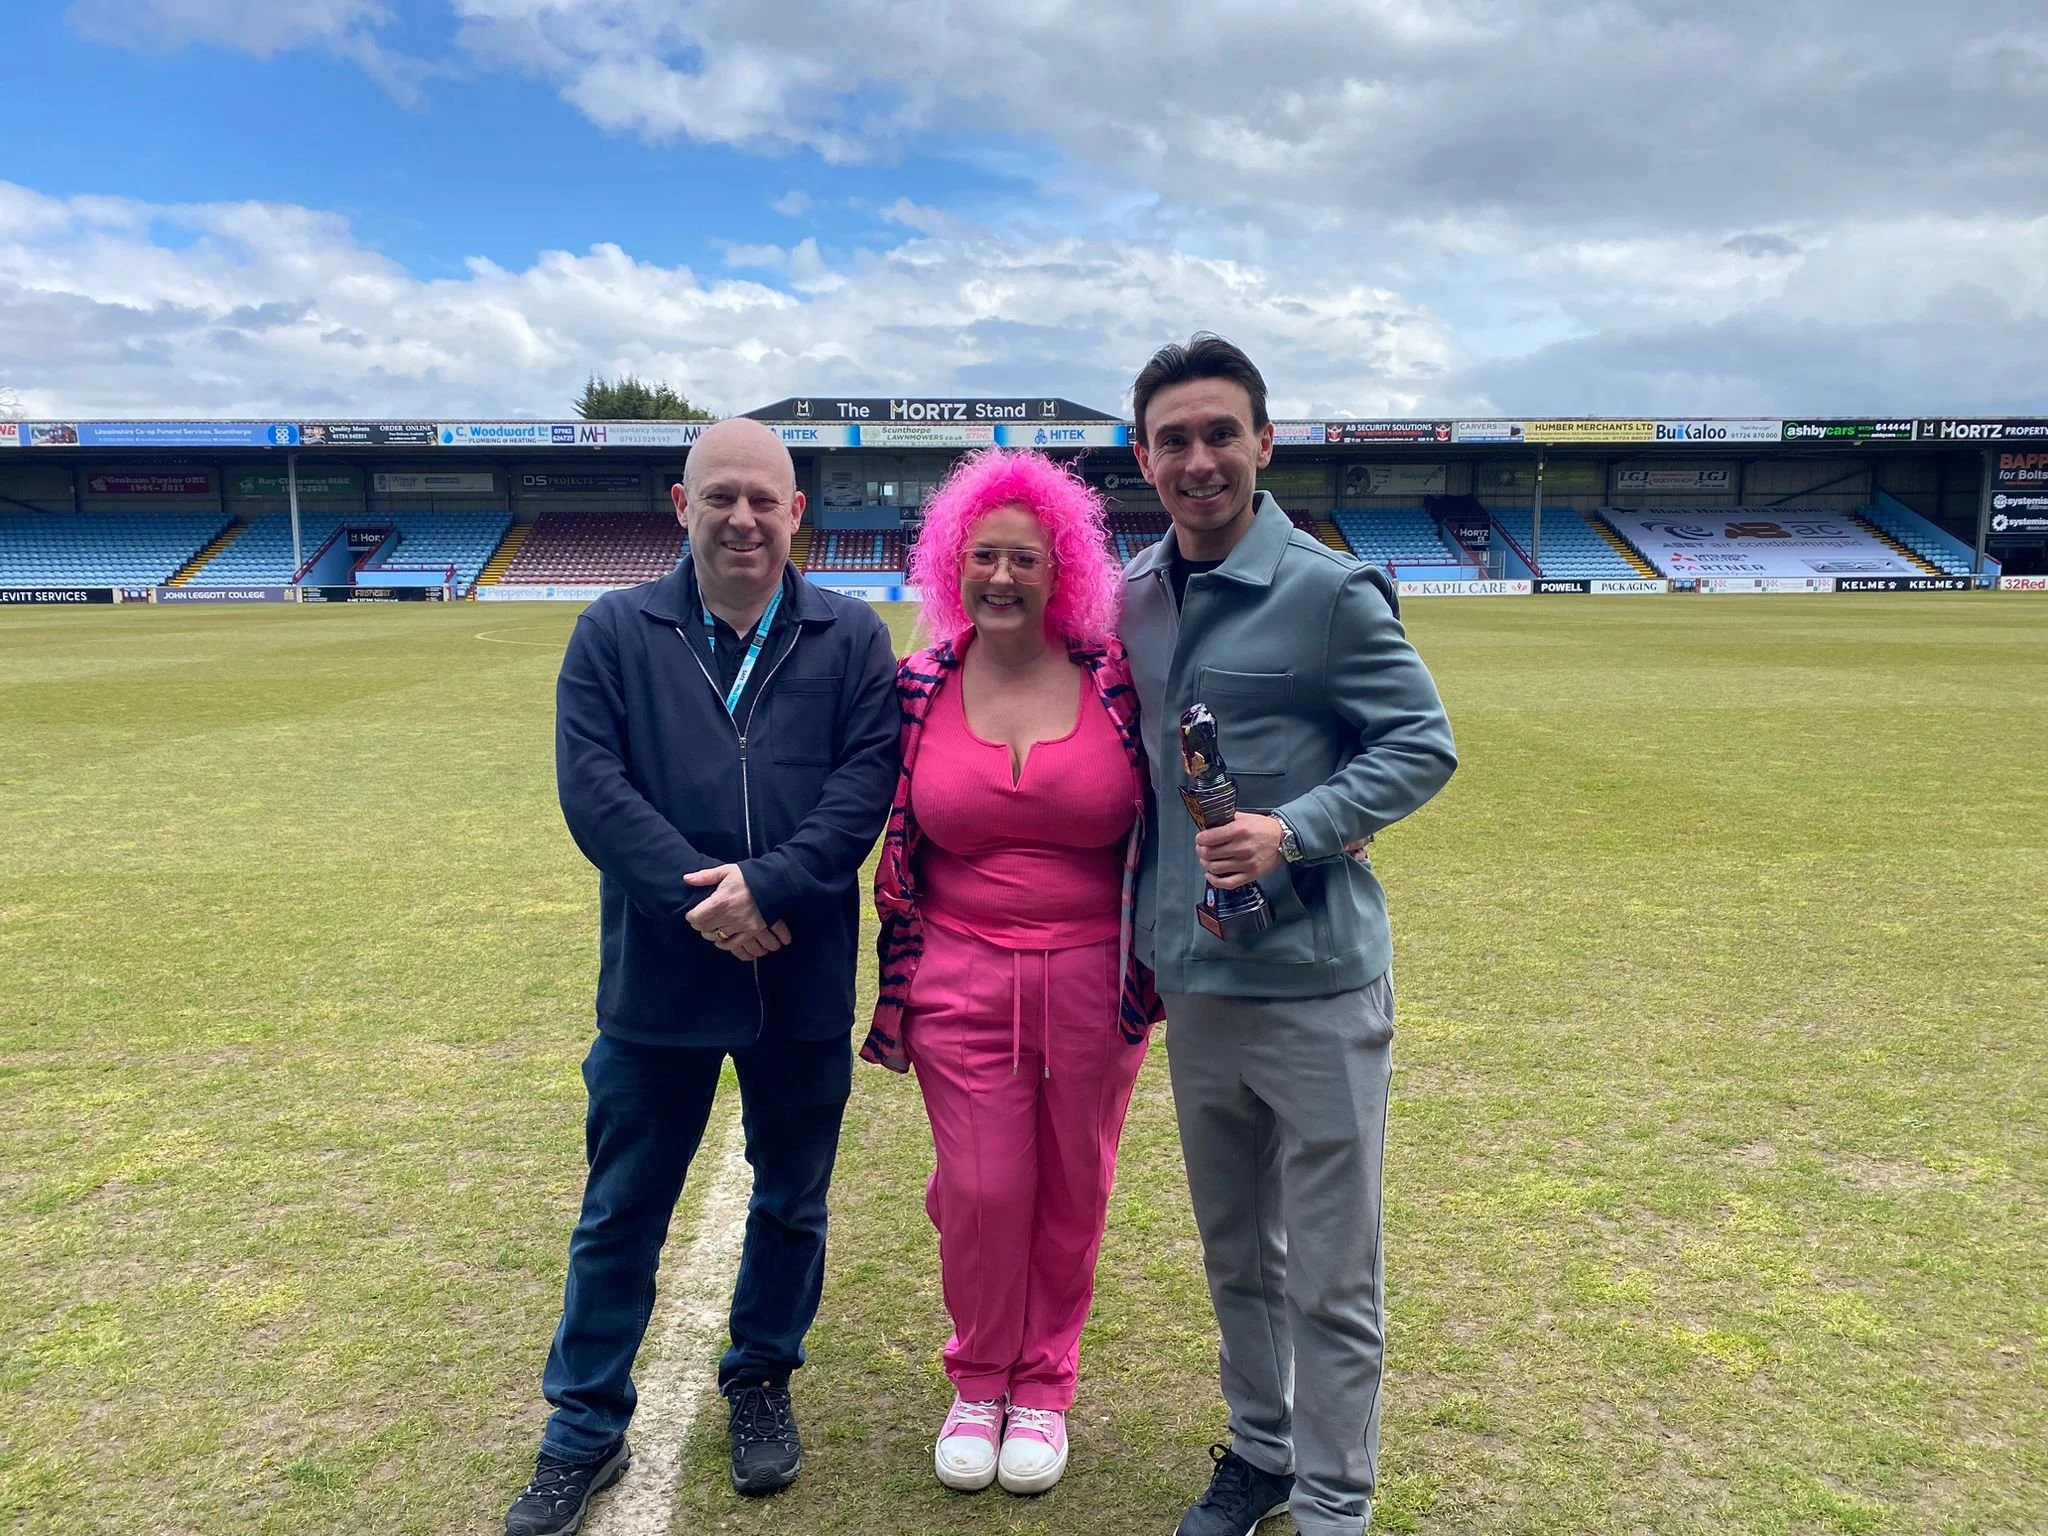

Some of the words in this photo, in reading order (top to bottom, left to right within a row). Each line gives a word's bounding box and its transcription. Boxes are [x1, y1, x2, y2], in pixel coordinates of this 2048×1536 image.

[837, 403, 870, 418] The
[890, 399, 967, 420] MORTZ
[975, 403, 1026, 418] Stand
[456, 427, 467, 437] C.
[470, 426, 535, 437] Woodward
[882, 426, 931, 435] Scunthorpe
[1392, 423, 1433, 431] SOLUTIONS
[1535, 423, 1574, 431] HUMBER
[1576, 423, 1633, 431] MERCHANTS
[1636, 423, 1653, 431] LTD
[1786, 425, 1856, 438] ashbycars
[1940, 421, 2003, 439] MORTZ
[2005, 426, 2048, 436] PROPERTY
[135, 428, 155, 437] Co-op
[213, 428, 252, 437] Scunthorpe
[580, 426, 607, 443] MH
[609, 427, 650, 435] Accountancy
[783, 429, 818, 440] HITEK
[1050, 429, 1085, 440] HITEK
[1999, 470, 2015, 480] for
[2018, 470, 2048, 480] Bolts
[108, 476, 149, 484] Graham
[150, 476, 184, 485] Taylor
[258, 477, 277, 487] Ray
[523, 476, 547, 486] DS
[548, 478, 593, 486] PROJECTS
[1738, 540, 1841, 548] conditioning
[1423, 583, 1465, 594] KAPIL
[1469, 582, 1507, 593] CARE
[1541, 583, 1583, 592] POWELL
[1601, 582, 1657, 591] PACKAGING
[1842, 581, 1885, 590] KELME
[1909, 580, 1953, 589] KELME
[2005, 578, 2046, 589] 32Red
[35, 591, 87, 601] SERVICES
[163, 591, 187, 600] JOHN
[188, 591, 226, 599] LEGGOTT
[228, 591, 265, 599] COLLEGE
[844, 589, 868, 597] HITEK
